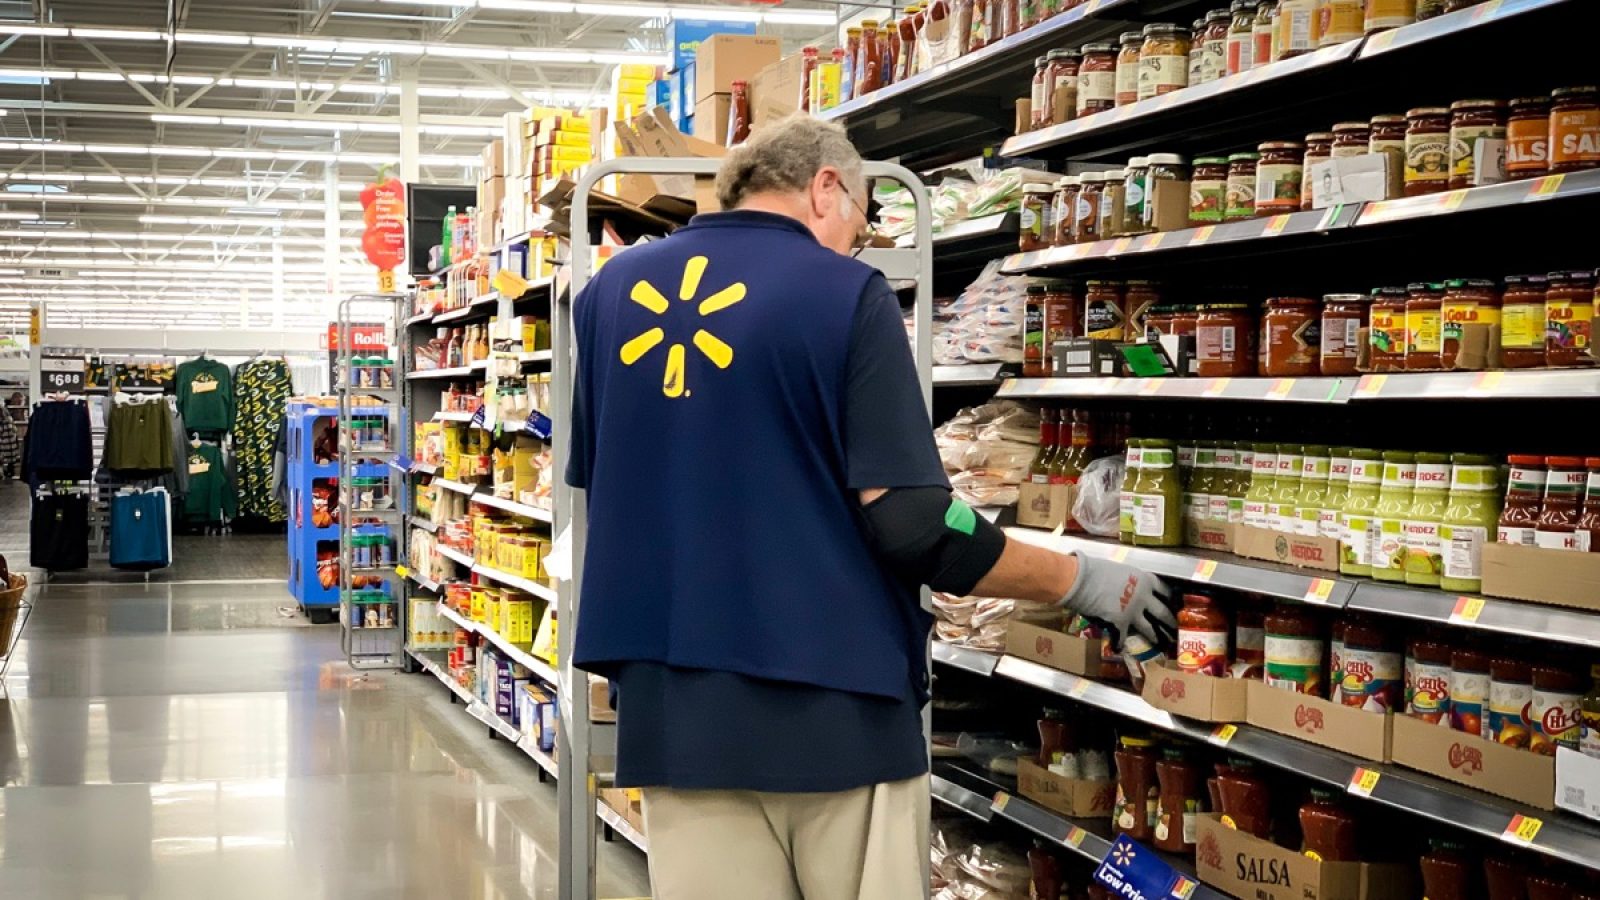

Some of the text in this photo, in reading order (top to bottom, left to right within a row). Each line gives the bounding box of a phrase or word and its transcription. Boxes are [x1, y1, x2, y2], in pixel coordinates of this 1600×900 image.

[380, 276, 393, 288] 13
[1099, 867, 1147, 900] Low Pric
[1236, 852, 1291, 888] SALSA
